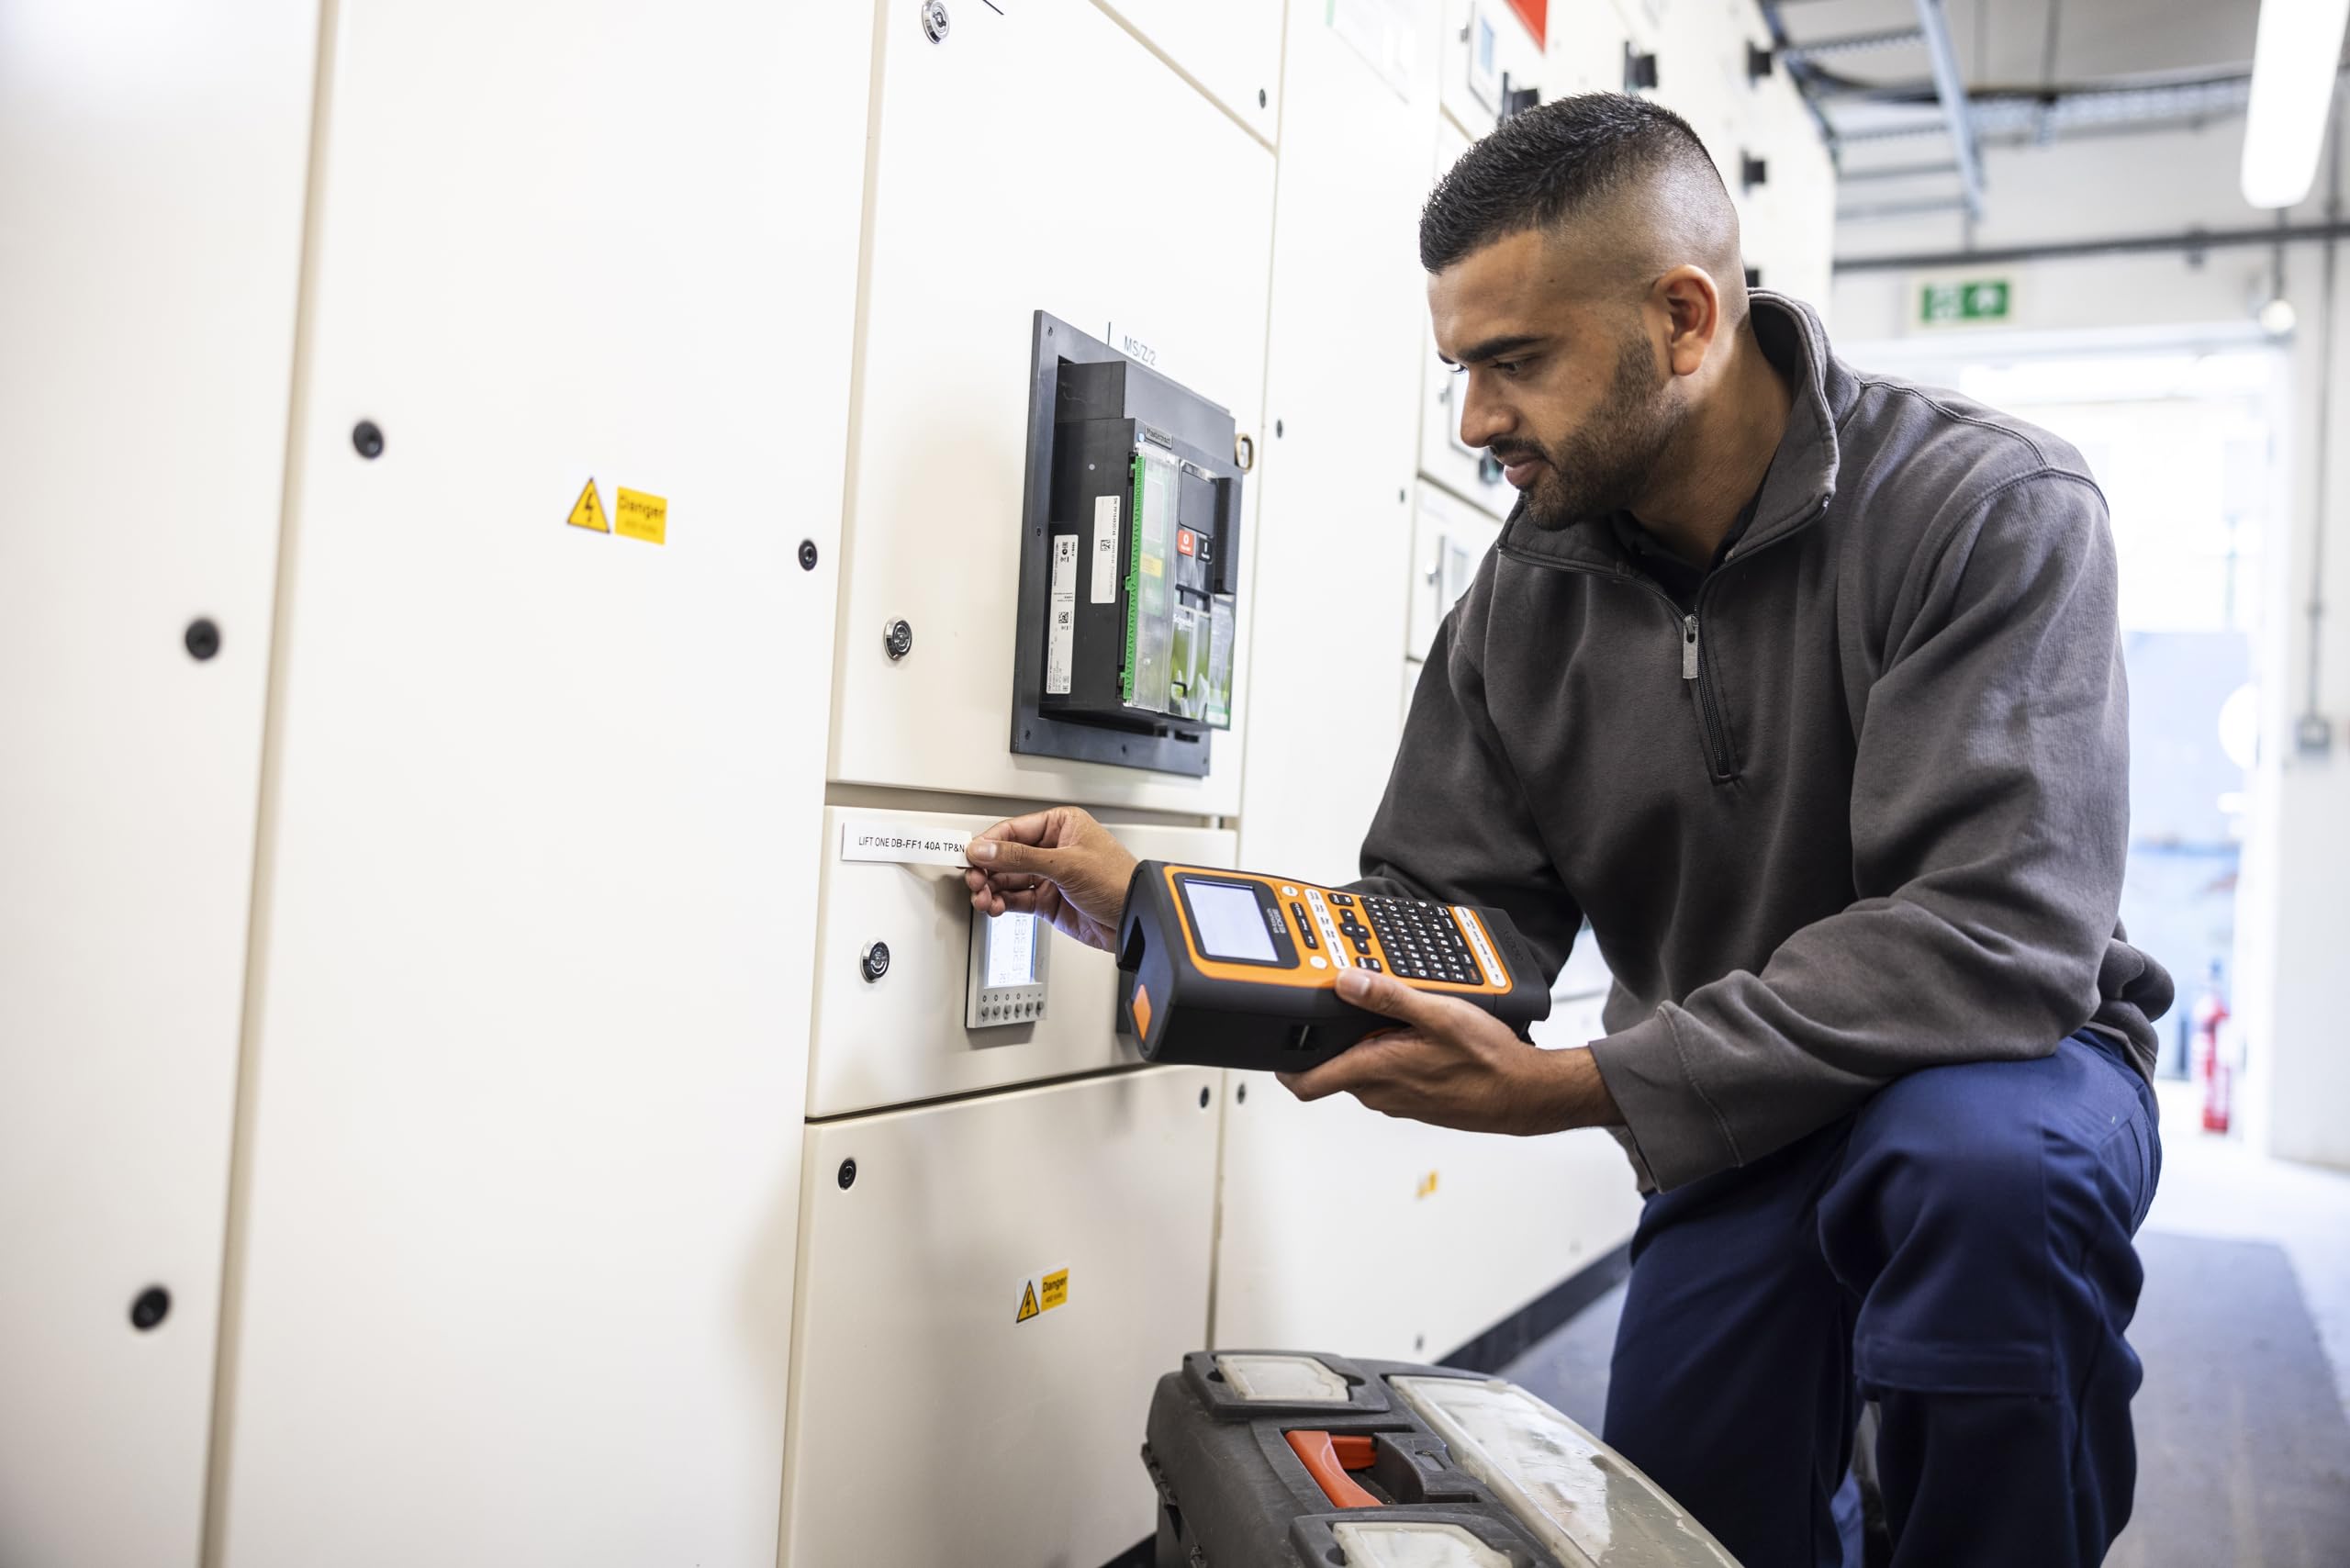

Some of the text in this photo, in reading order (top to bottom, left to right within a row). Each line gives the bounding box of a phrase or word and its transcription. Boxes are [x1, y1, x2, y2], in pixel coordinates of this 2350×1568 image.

[619, 496, 665, 521] Danger
[858, 836, 965, 853] LIFT ONE DB-FF1 40A TP&N
[1043, 1276, 1068, 1293] Danger
